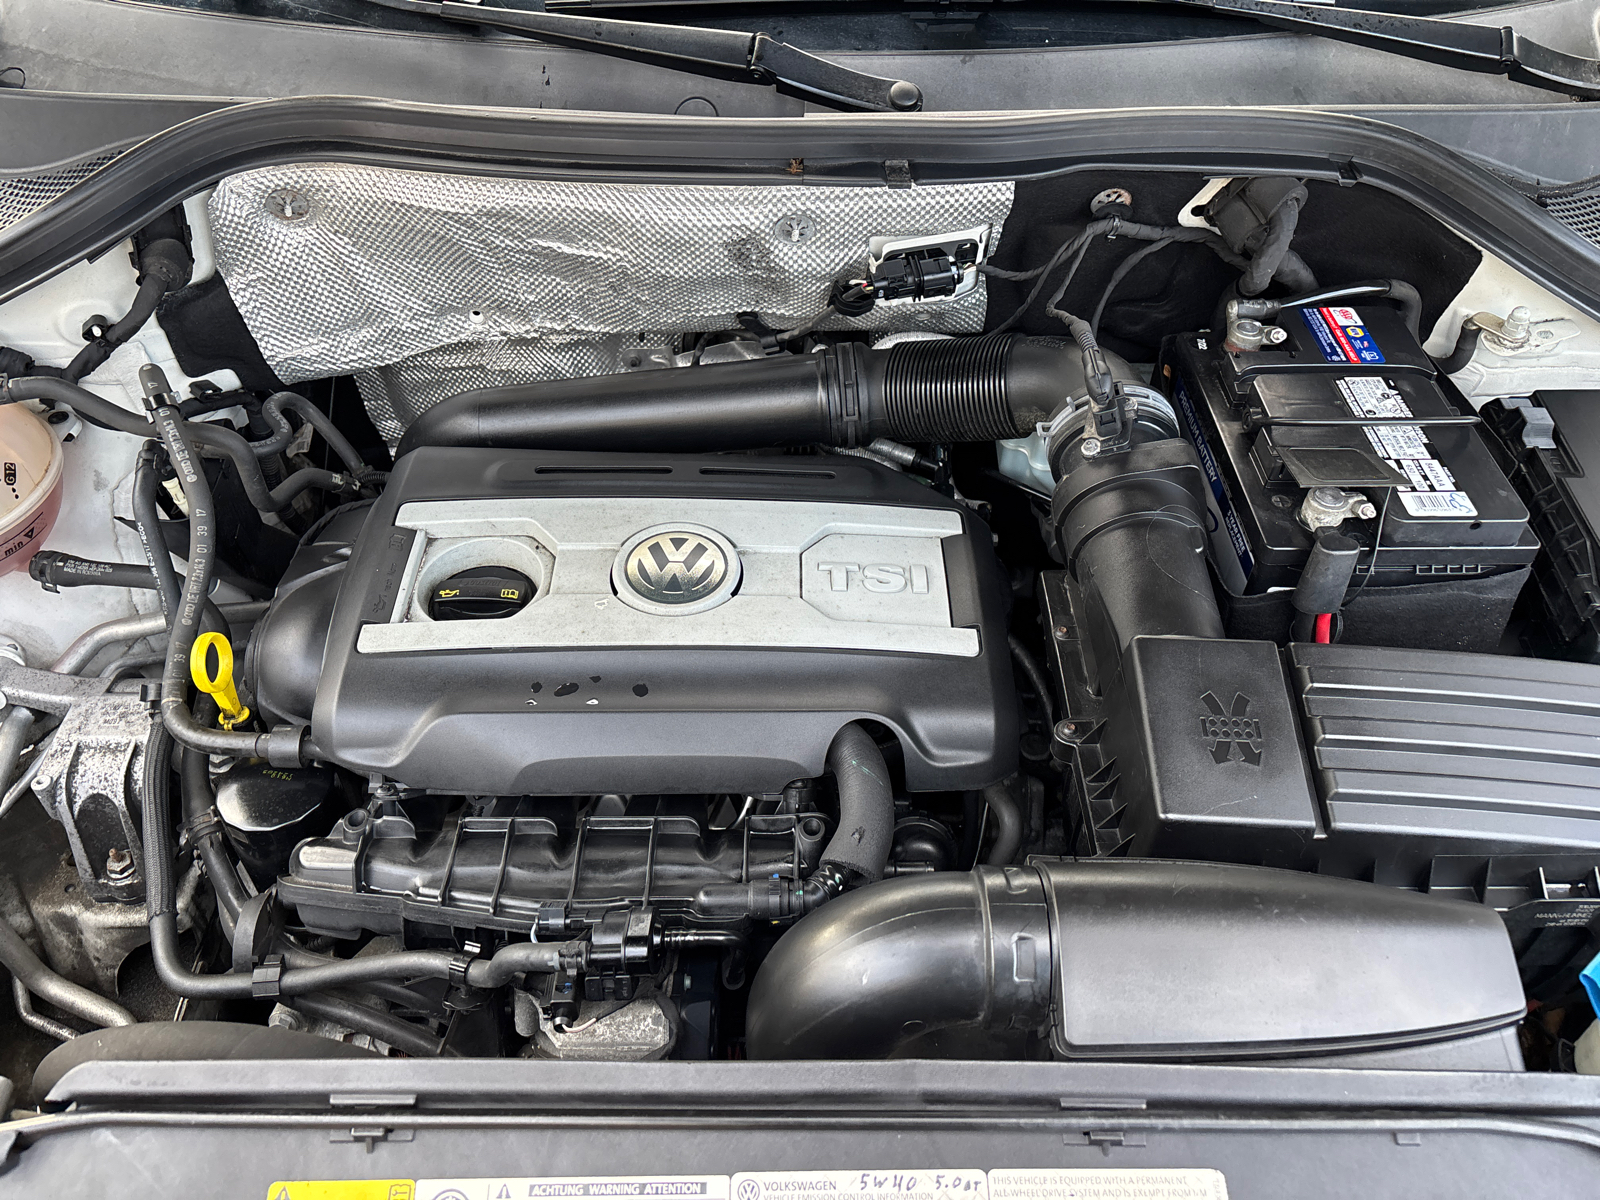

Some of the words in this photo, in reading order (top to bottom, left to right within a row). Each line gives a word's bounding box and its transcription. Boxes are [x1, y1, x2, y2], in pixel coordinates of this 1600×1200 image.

[1178, 390, 1200, 437] PREMIUM
[1196, 437, 1218, 483] BATTERY
[6, 463, 15, 483] G12
[196, 508, 207, 517] 17
[197, 525, 208, 537] 39
[1229, 516, 1239, 535] YEAR
[1236, 532, 1246, 554] FREE
[4, 541, 24, 557] min
[196, 544, 208, 554] 01
[817, 561, 930, 594] TSI
[763, 1181, 837, 1191] VOLKSWAGEN
[992, 1176, 1012, 1185] THIS
[1013, 1176, 1048, 1185] VEHICLE
[1050, 1176, 1058, 1185] IS
[1060, 1176, 1101, 1187] EQUIPPED
[1103, 1176, 1126, 1185] WITH
[1128, 1176, 1135, 1185] A
[1136, 1176, 1187, 1185] PERMANENT
[532, 1183, 584, 1196] ACHTUNG
[589, 1183, 640, 1195] WARNING
[644, 1182, 701, 1194] ATTENTION
[1069, 1188, 1100, 1197] SYSTEM
[1102, 1188, 1122, 1198] AND
[1123, 1188, 1131, 1197] IS
[1133, 1188, 1166, 1197] EXEMPT
[877, 1192, 934, 1200] INFORMATION
